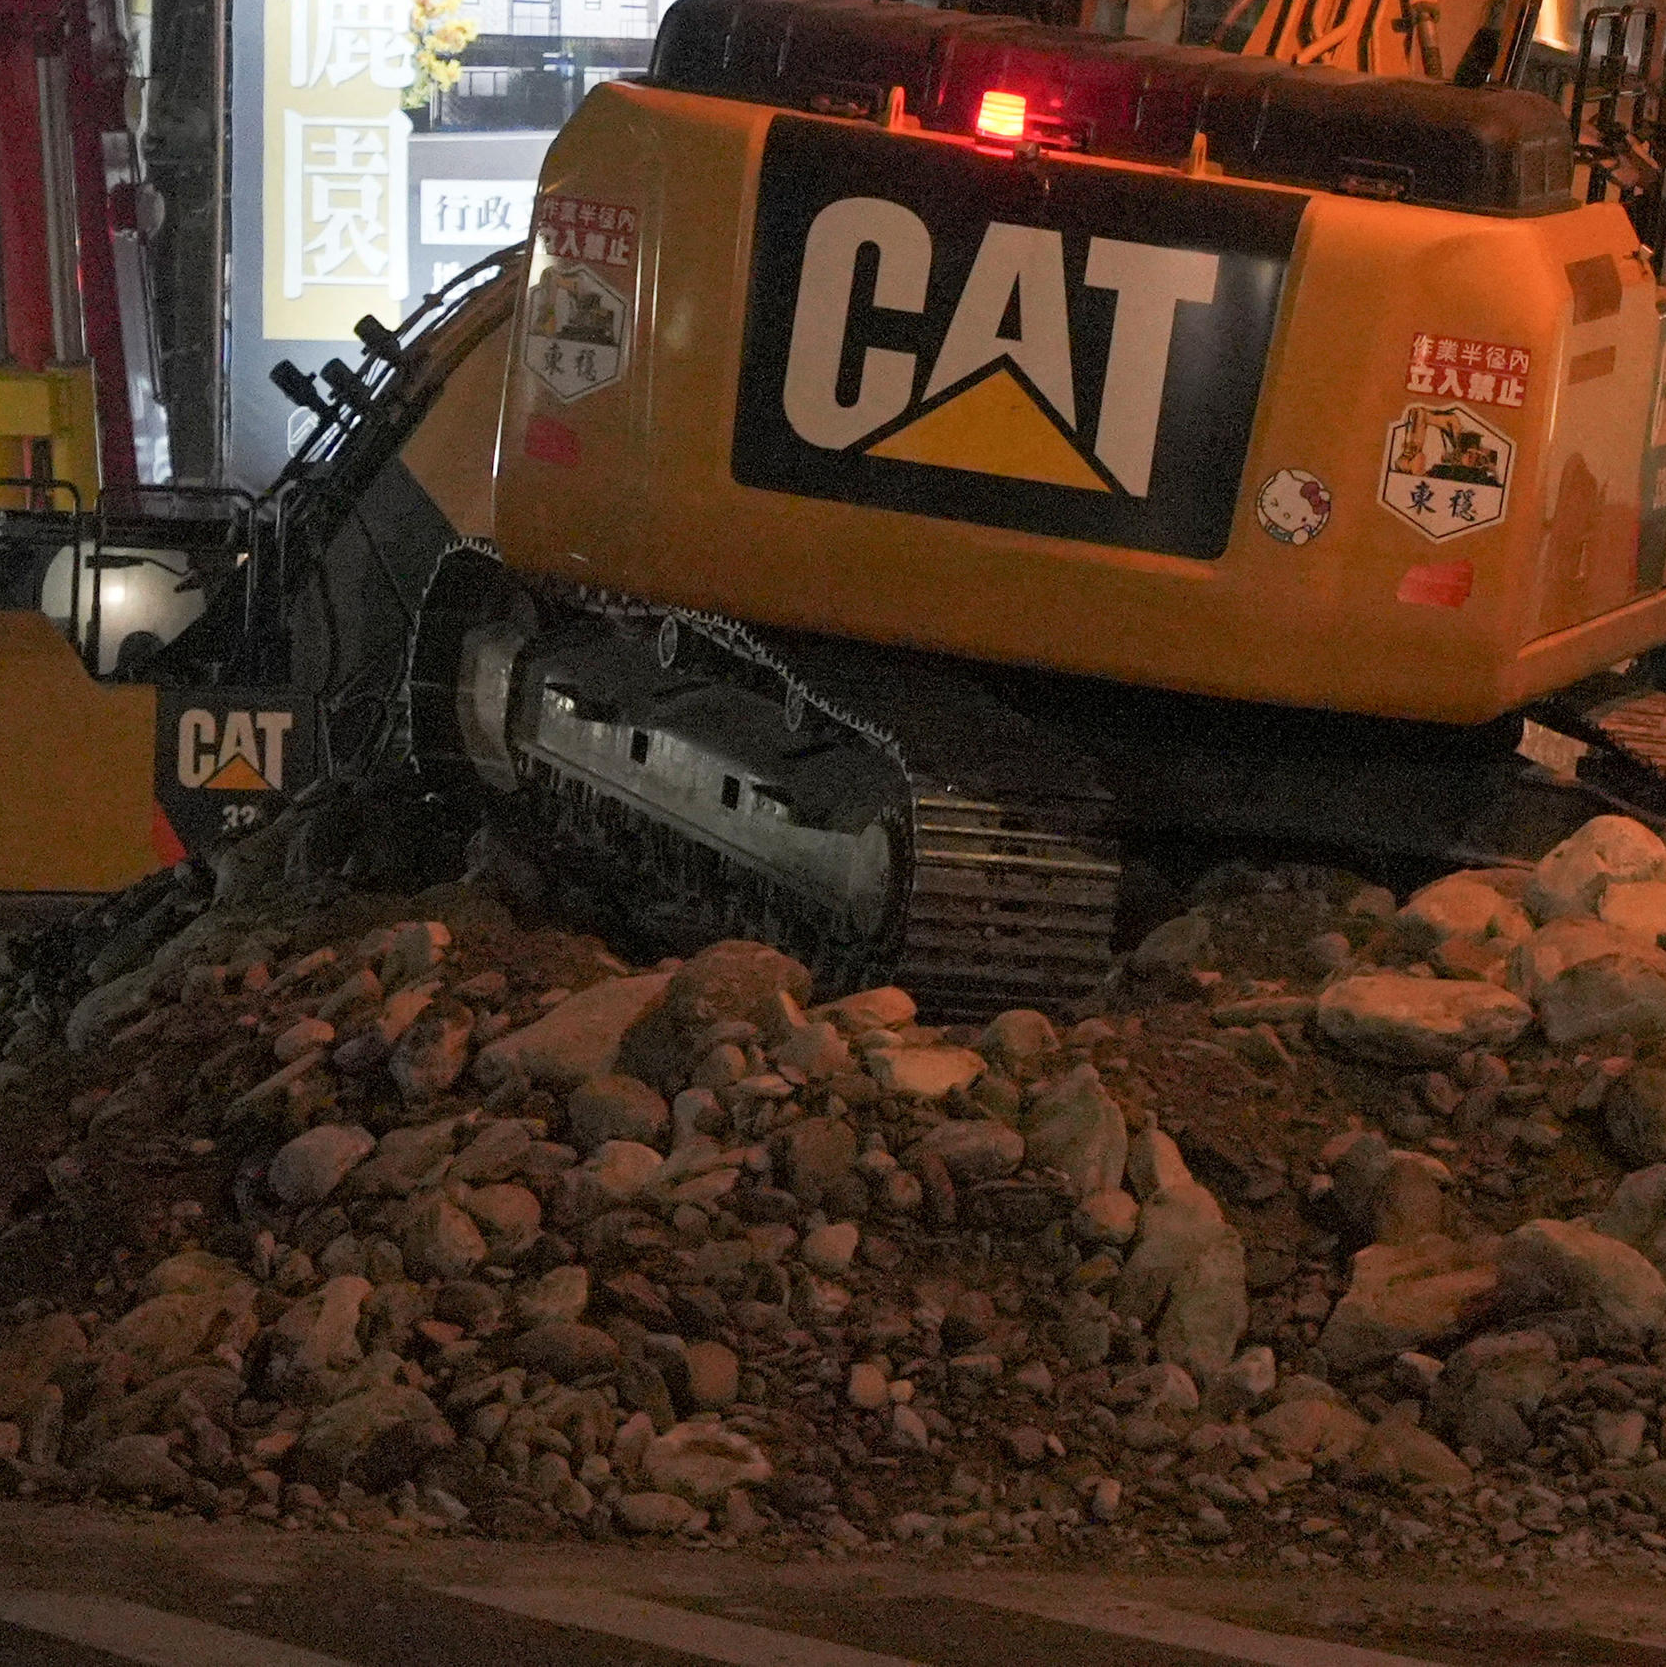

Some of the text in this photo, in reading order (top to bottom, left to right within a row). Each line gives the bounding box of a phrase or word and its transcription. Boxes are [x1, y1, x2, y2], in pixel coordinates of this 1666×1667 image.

[782, 195, 1218, 498] CAT
[1405, 364, 1526, 408] 立入禁止
[177, 709, 294, 792] CAT
